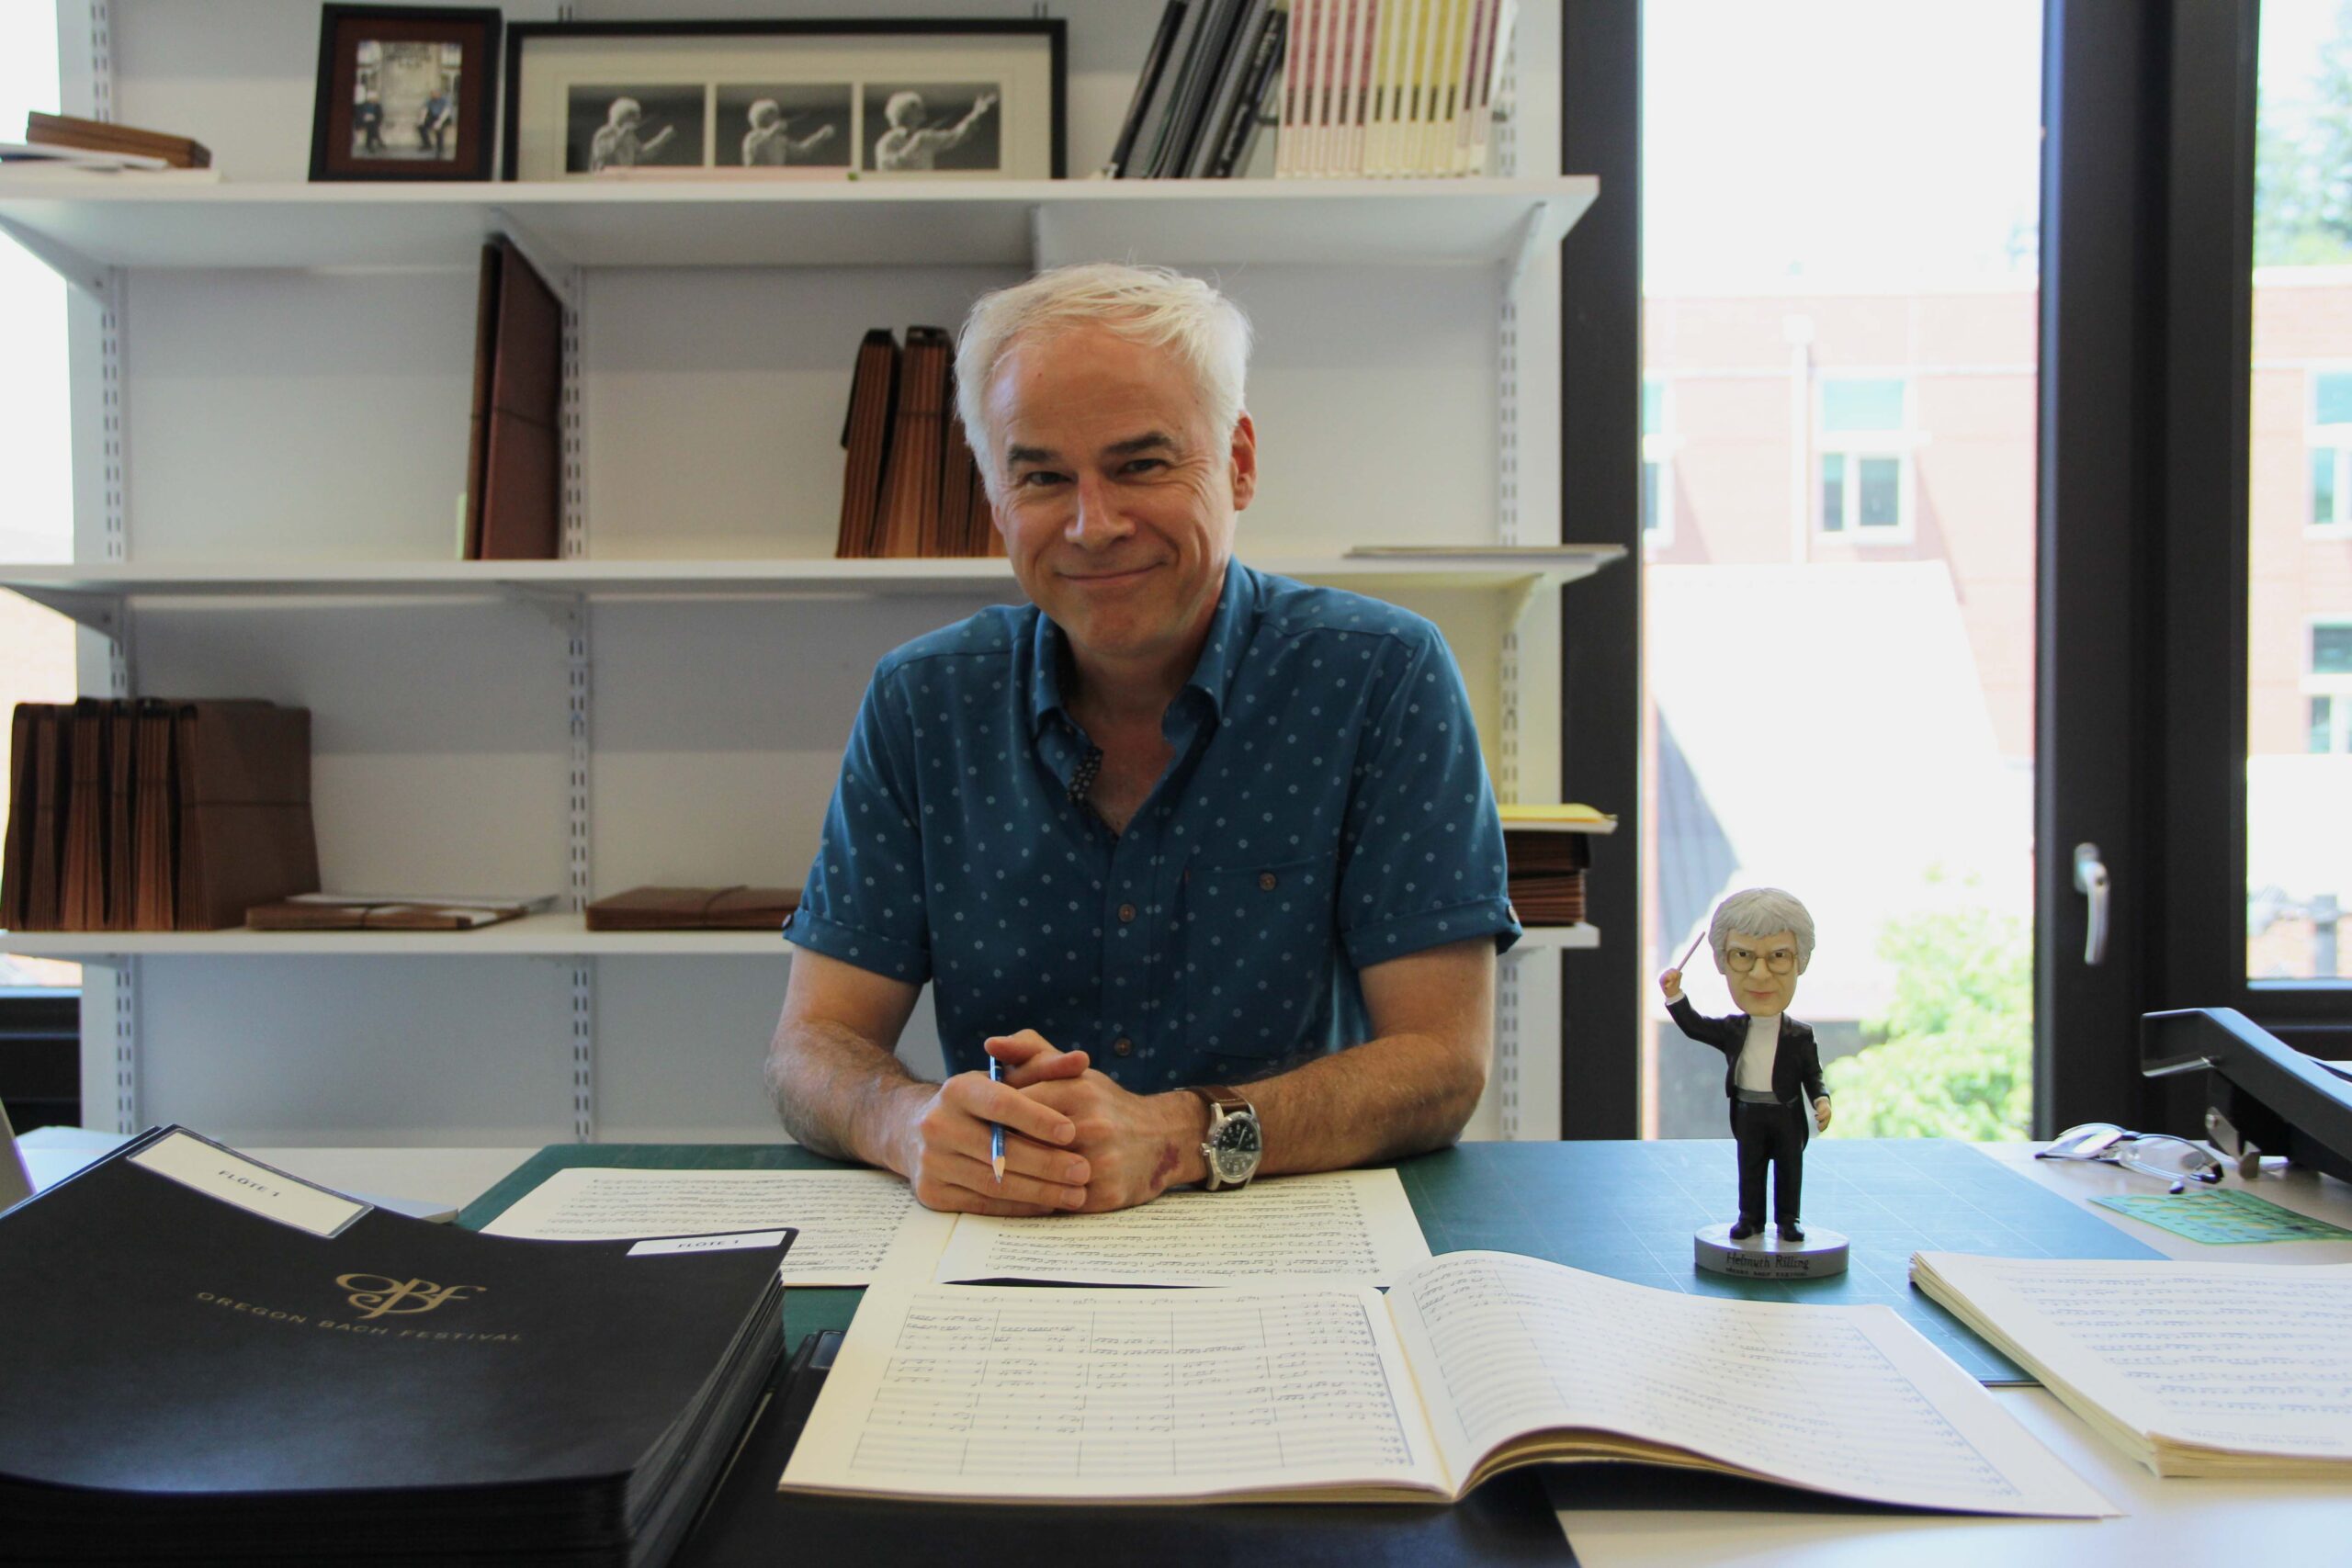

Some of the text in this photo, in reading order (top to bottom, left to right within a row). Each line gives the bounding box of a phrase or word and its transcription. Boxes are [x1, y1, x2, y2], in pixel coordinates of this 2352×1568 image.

[1725, 1251, 1809, 1270] Helmuth Rilling
[197, 1292, 522, 1341] OREGON BACH FESTIVAL
